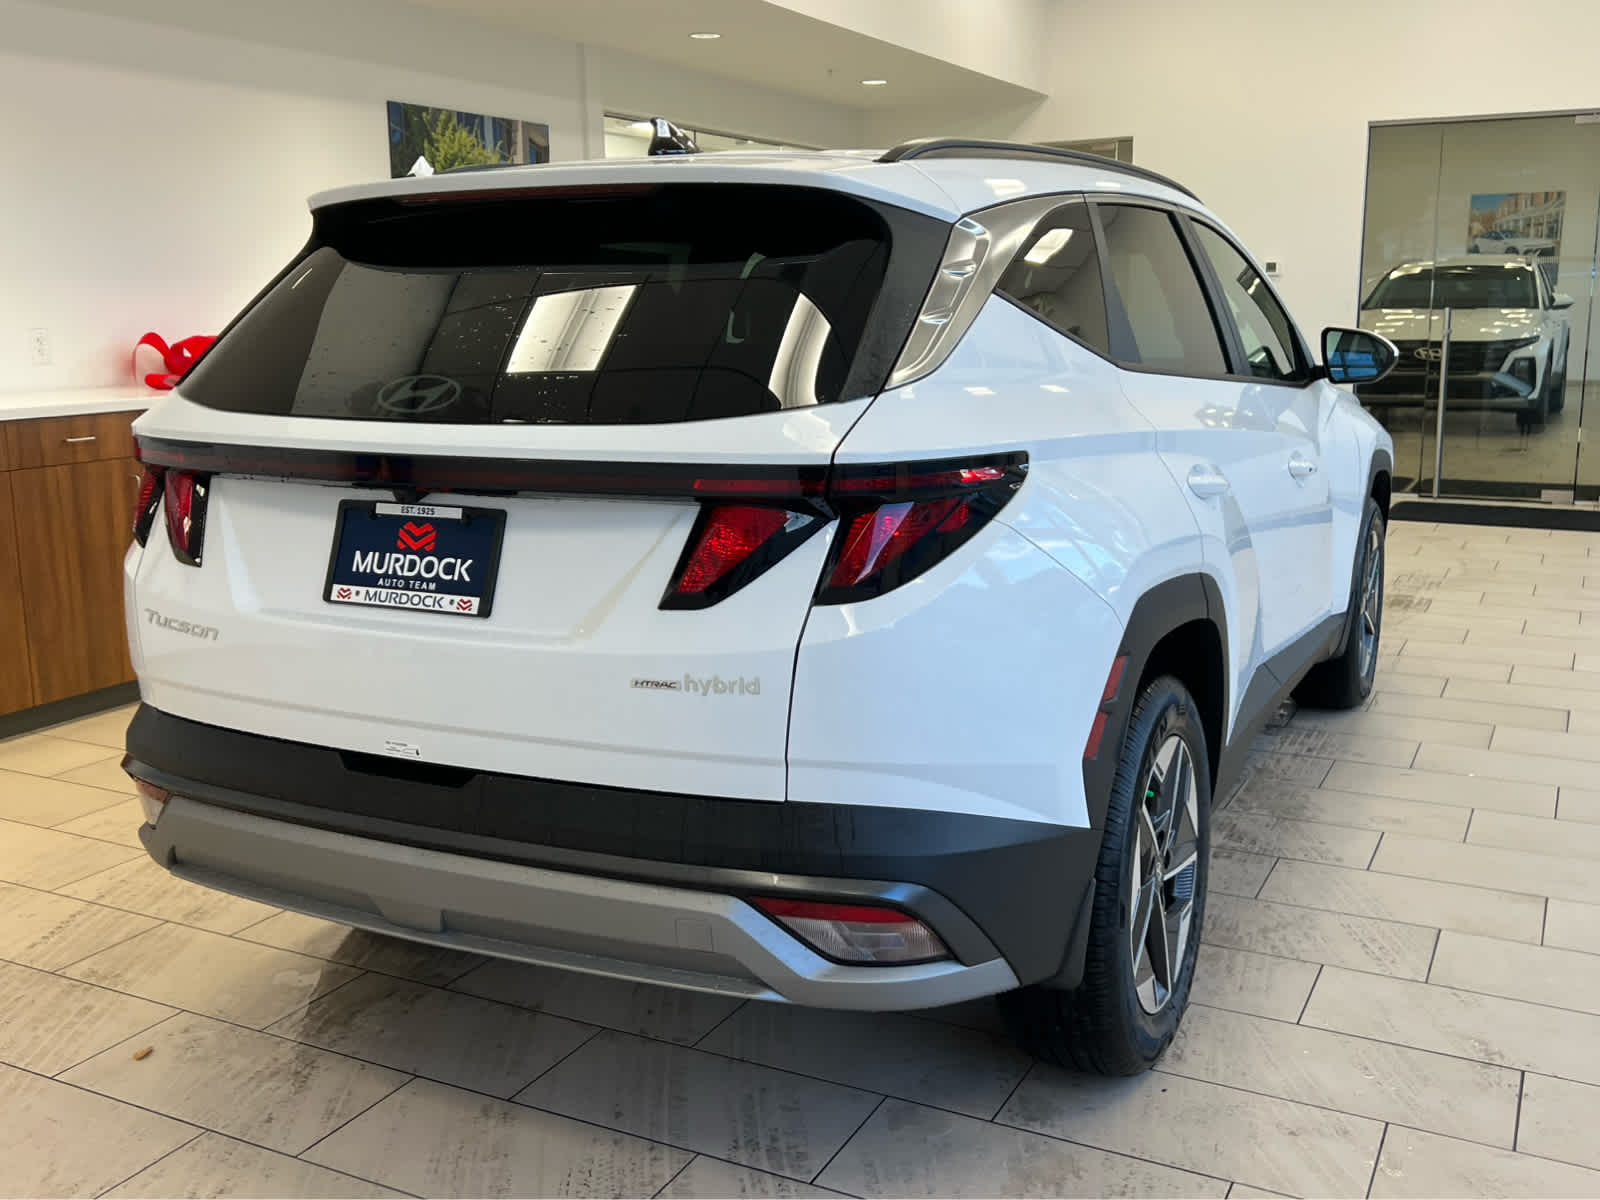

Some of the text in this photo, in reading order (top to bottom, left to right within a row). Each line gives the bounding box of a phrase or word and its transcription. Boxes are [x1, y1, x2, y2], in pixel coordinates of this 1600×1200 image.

[401, 506, 435, 515] EST. 1925
[352, 550, 473, 582] MURDOCK
[377, 578, 436, 590] AUTO TEAM
[364, 589, 445, 609] MURDOCK
[634, 673, 761, 697] HTRAC hybrid
